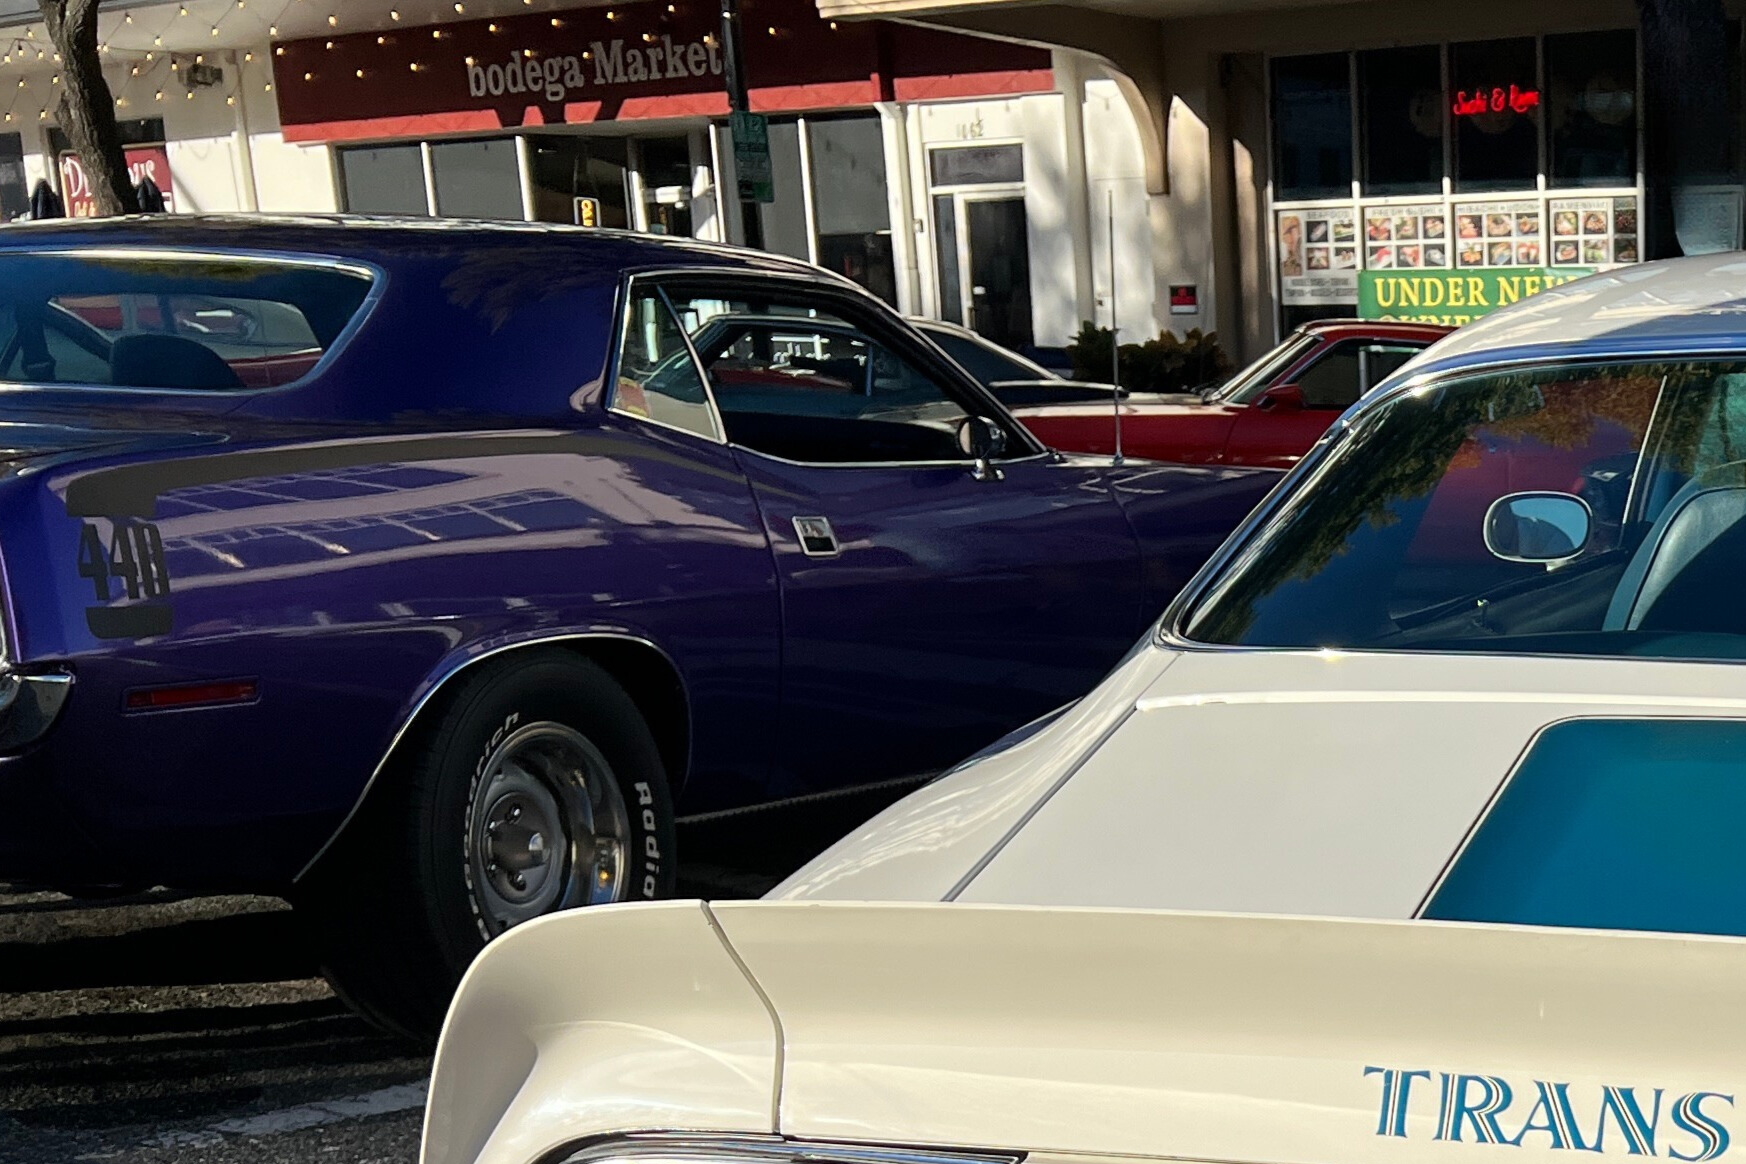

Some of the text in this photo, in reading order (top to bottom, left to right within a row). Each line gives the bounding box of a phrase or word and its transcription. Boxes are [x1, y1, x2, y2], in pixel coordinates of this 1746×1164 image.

[467, 33, 723, 101] bodega Market
[1374, 276, 1490, 308] UNDER
[78, 522, 170, 600] 440
[634, 781, 661, 898] Radia
[1362, 1065, 1736, 1163] TRANS
